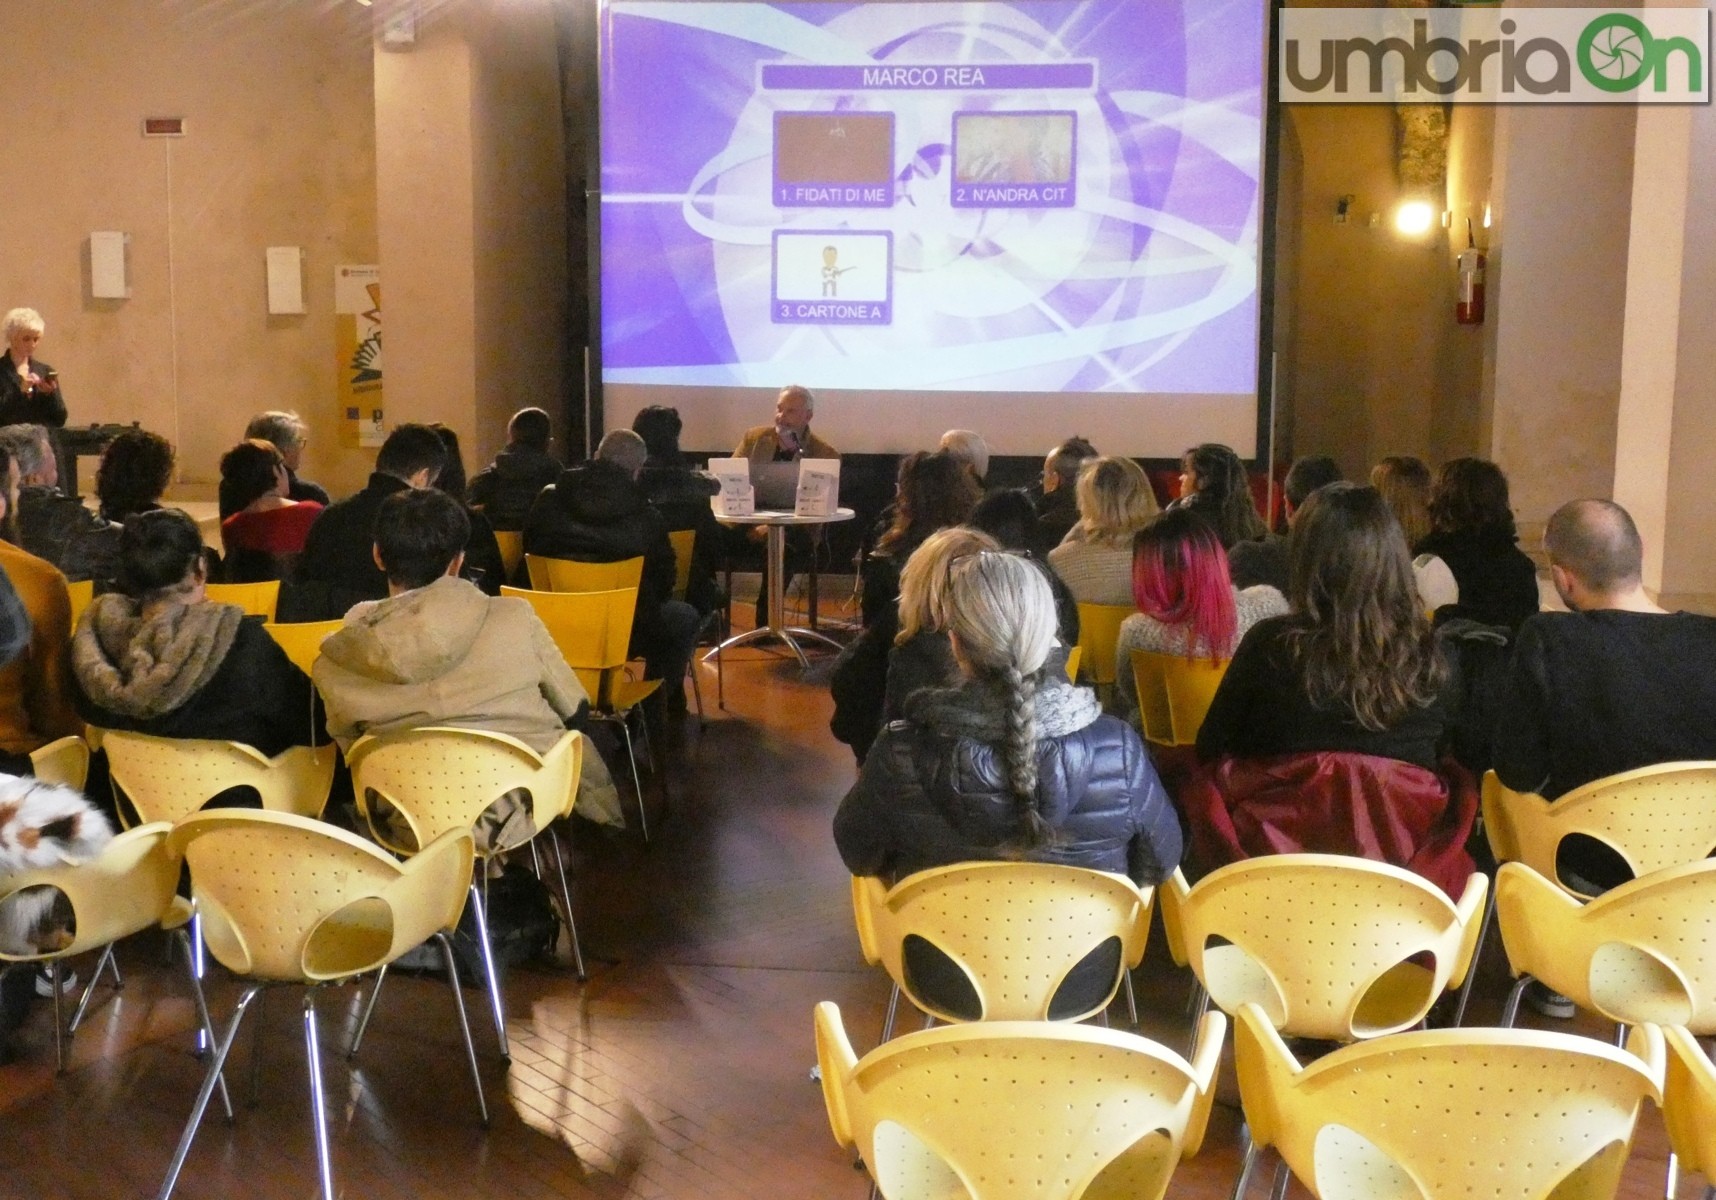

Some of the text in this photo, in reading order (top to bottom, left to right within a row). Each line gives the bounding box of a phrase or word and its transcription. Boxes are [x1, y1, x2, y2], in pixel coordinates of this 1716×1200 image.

[863, 67, 986, 86] MARCO REA
[781, 188, 886, 202] 1. FIDATI DI ME
[973, 188, 1039, 202] N'ANDRA
[1042, 187, 1068, 201] CIT
[780, 304, 882, 319] 3. CARTONE A
